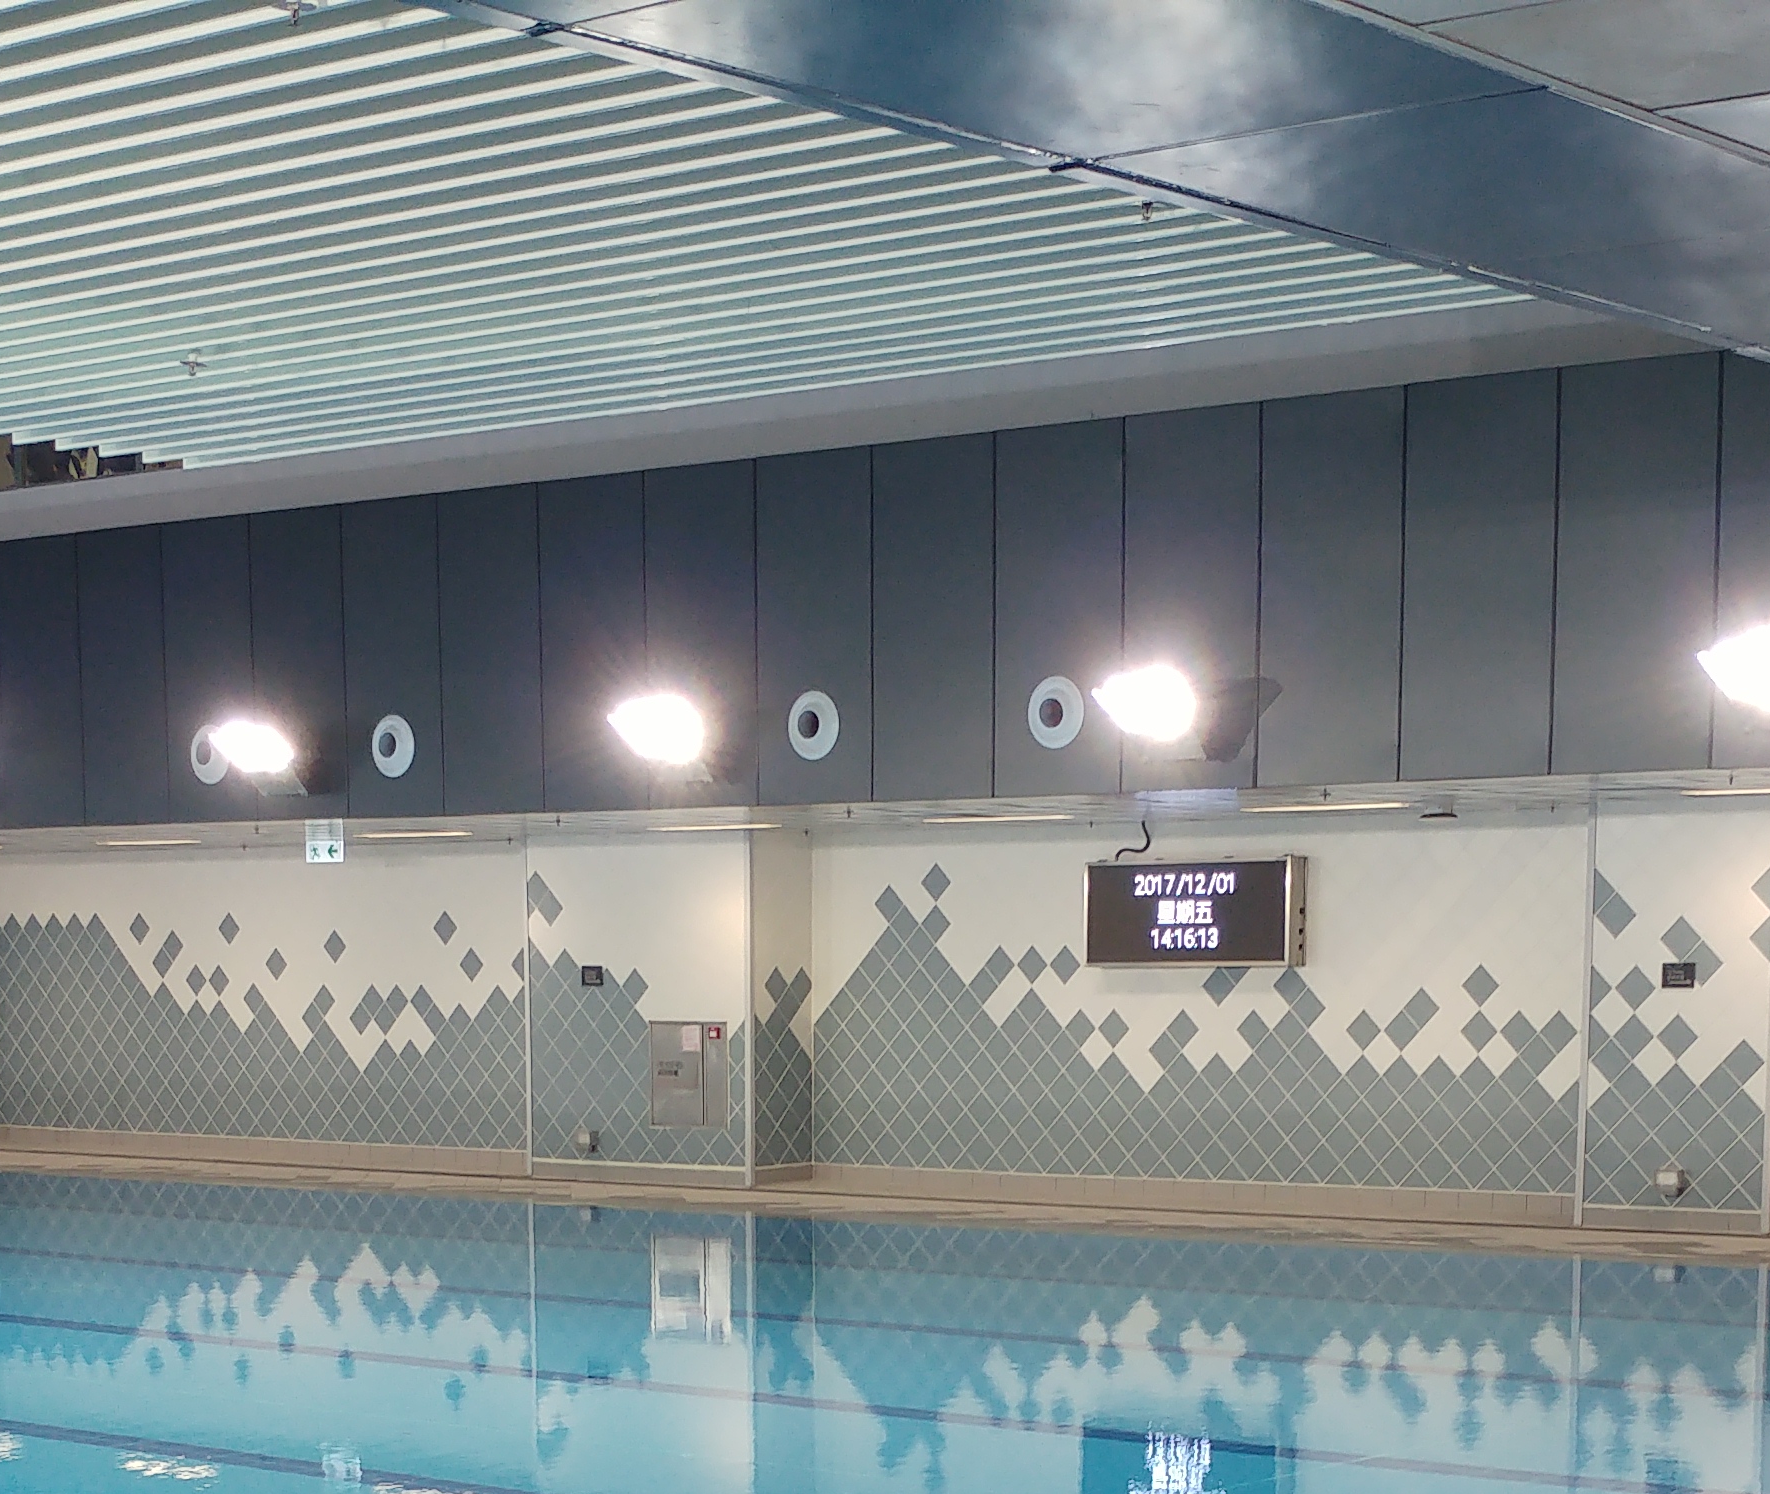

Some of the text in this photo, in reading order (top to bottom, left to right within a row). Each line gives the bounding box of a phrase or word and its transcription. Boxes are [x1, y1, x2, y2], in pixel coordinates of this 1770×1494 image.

[1133, 871, 1235, 896] 2017/12/01
[1157, 900, 1213, 924] 星期五
[1150, 927, 1219, 949] 14:16:13
